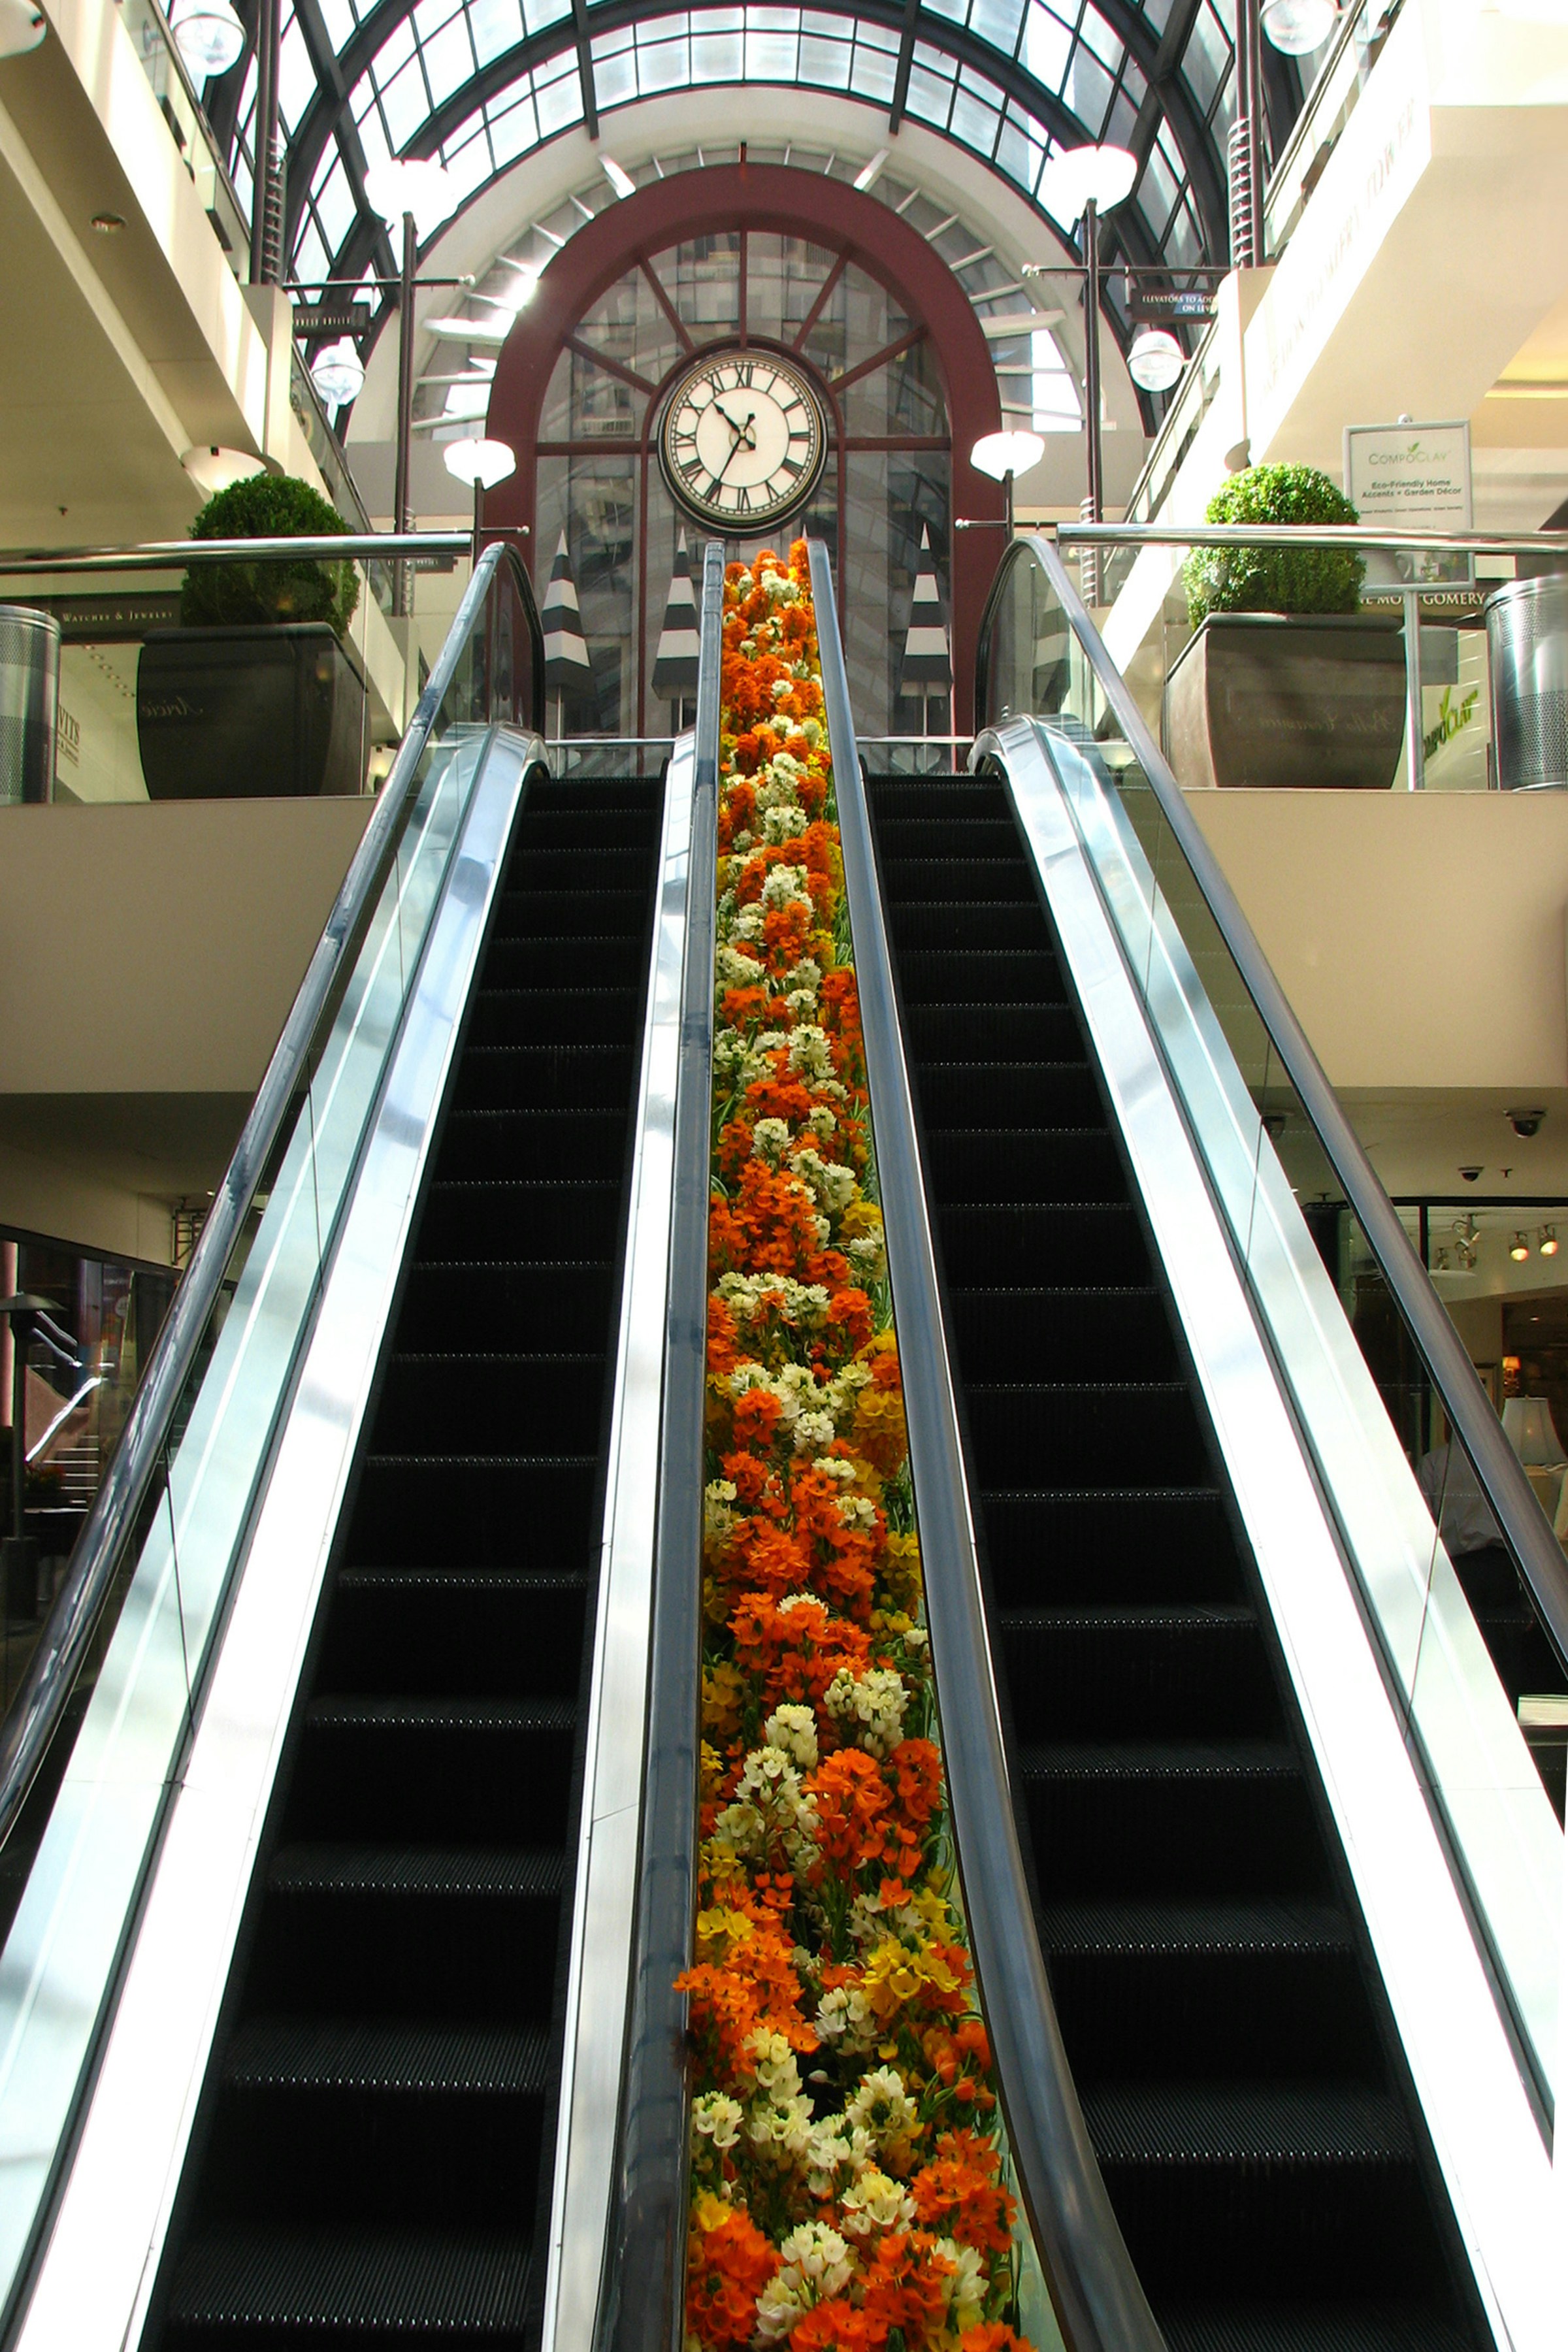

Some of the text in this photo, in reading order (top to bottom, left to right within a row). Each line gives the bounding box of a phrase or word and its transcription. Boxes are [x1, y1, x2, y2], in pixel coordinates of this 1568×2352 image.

[1371, 479, 1451, 489] Eco-Friendly Home
[1362, 490, 1394, 498] Accents
[1377, 592, 1486, 606] MOGOMERY
